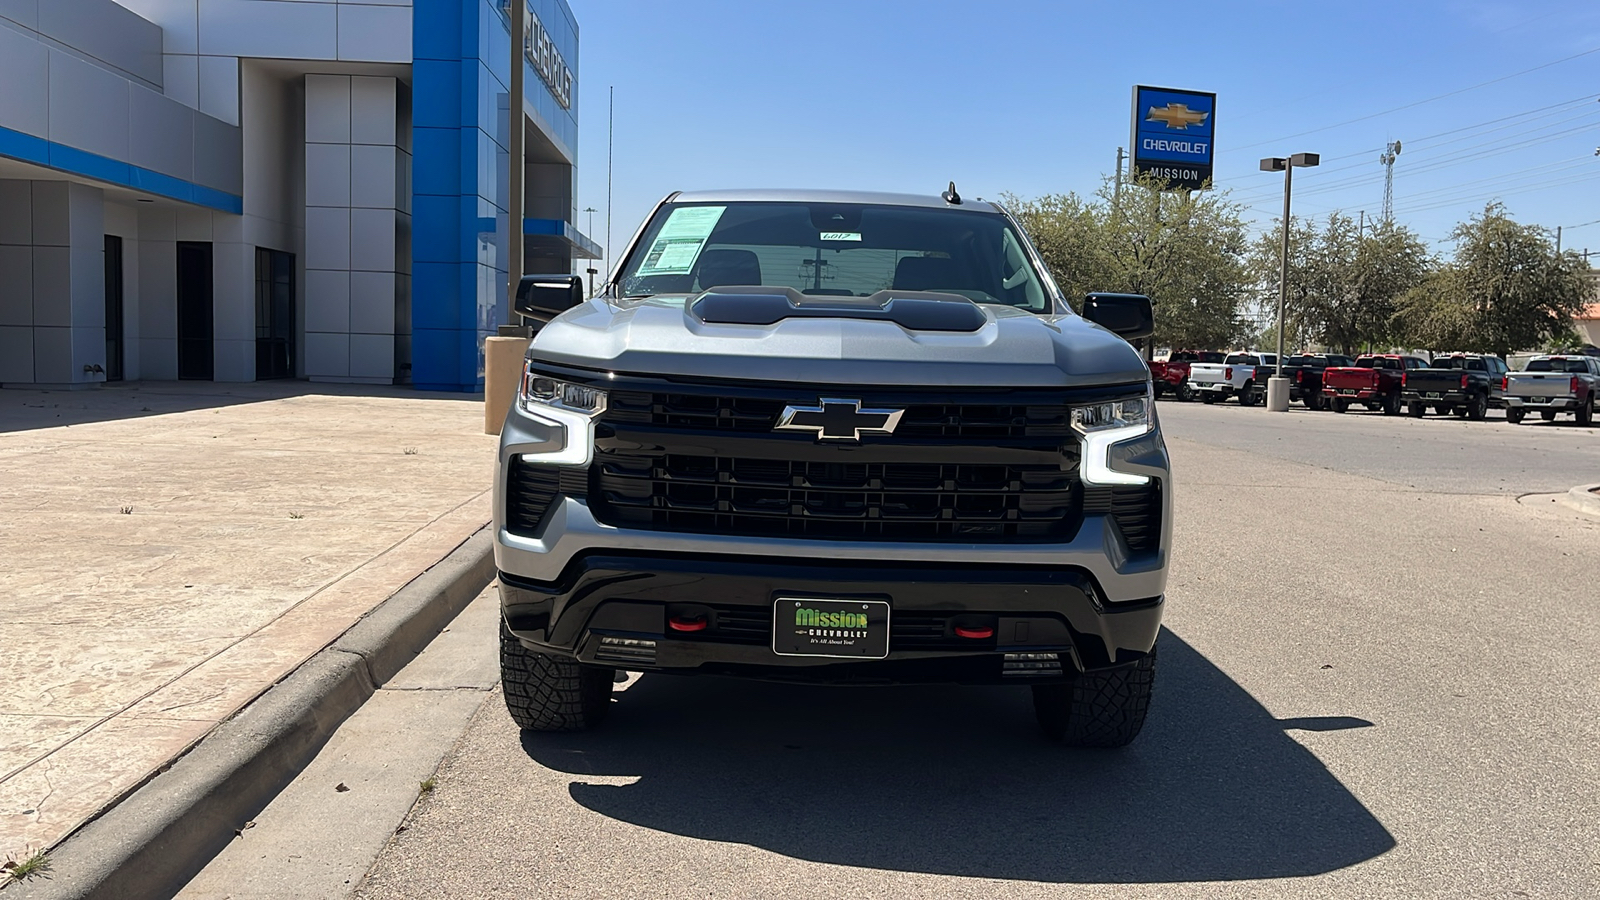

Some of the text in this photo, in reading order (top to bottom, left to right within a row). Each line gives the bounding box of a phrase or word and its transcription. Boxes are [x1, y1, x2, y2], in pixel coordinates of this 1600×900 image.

[532, 13, 573, 109] CHEVROLET
[1144, 139, 1207, 154] CHEVROLET
[1151, 168, 1198, 180] MISSION
[796, 608, 868, 628] Mission
[809, 629, 868, 638] CHEVROLET
